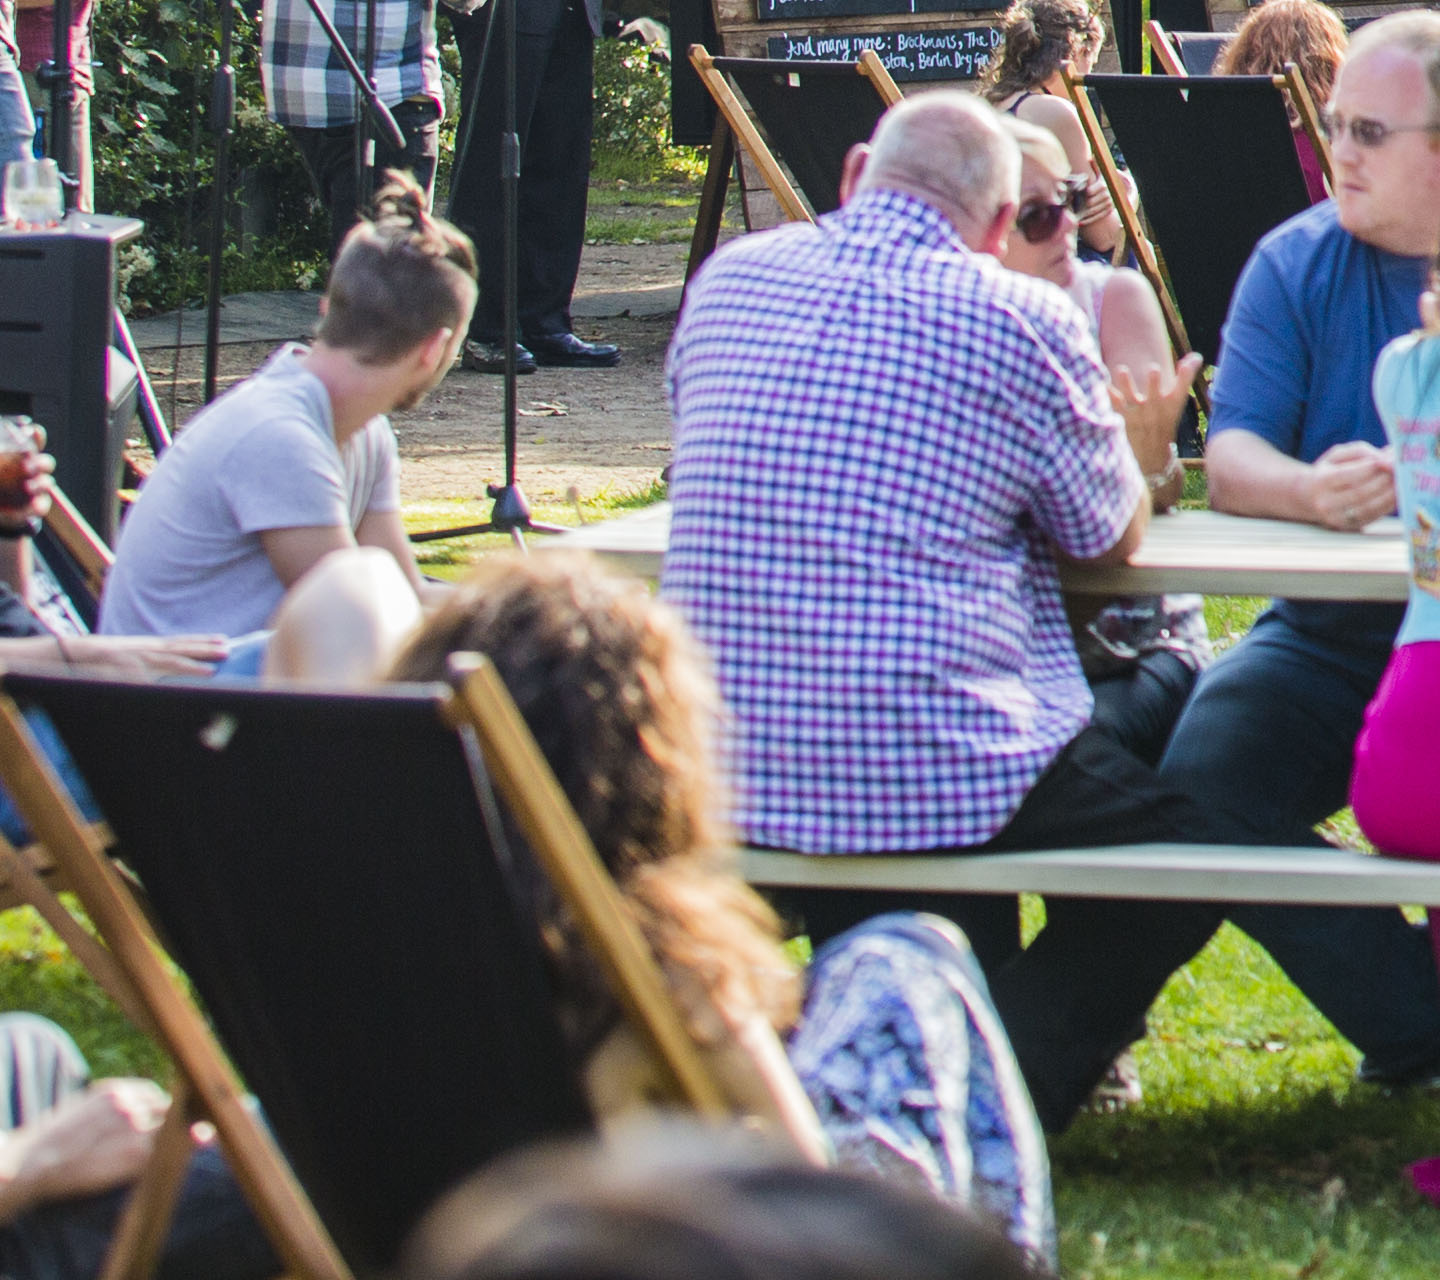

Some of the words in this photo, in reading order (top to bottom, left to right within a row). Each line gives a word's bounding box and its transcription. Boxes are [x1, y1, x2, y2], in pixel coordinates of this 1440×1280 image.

[786, 36, 816, 61] And
[816, 38, 851, 62] many
[963, 32, 989, 48] The
[918, 52, 953, 69] Berlin
[954, 51, 974, 74] Dry
